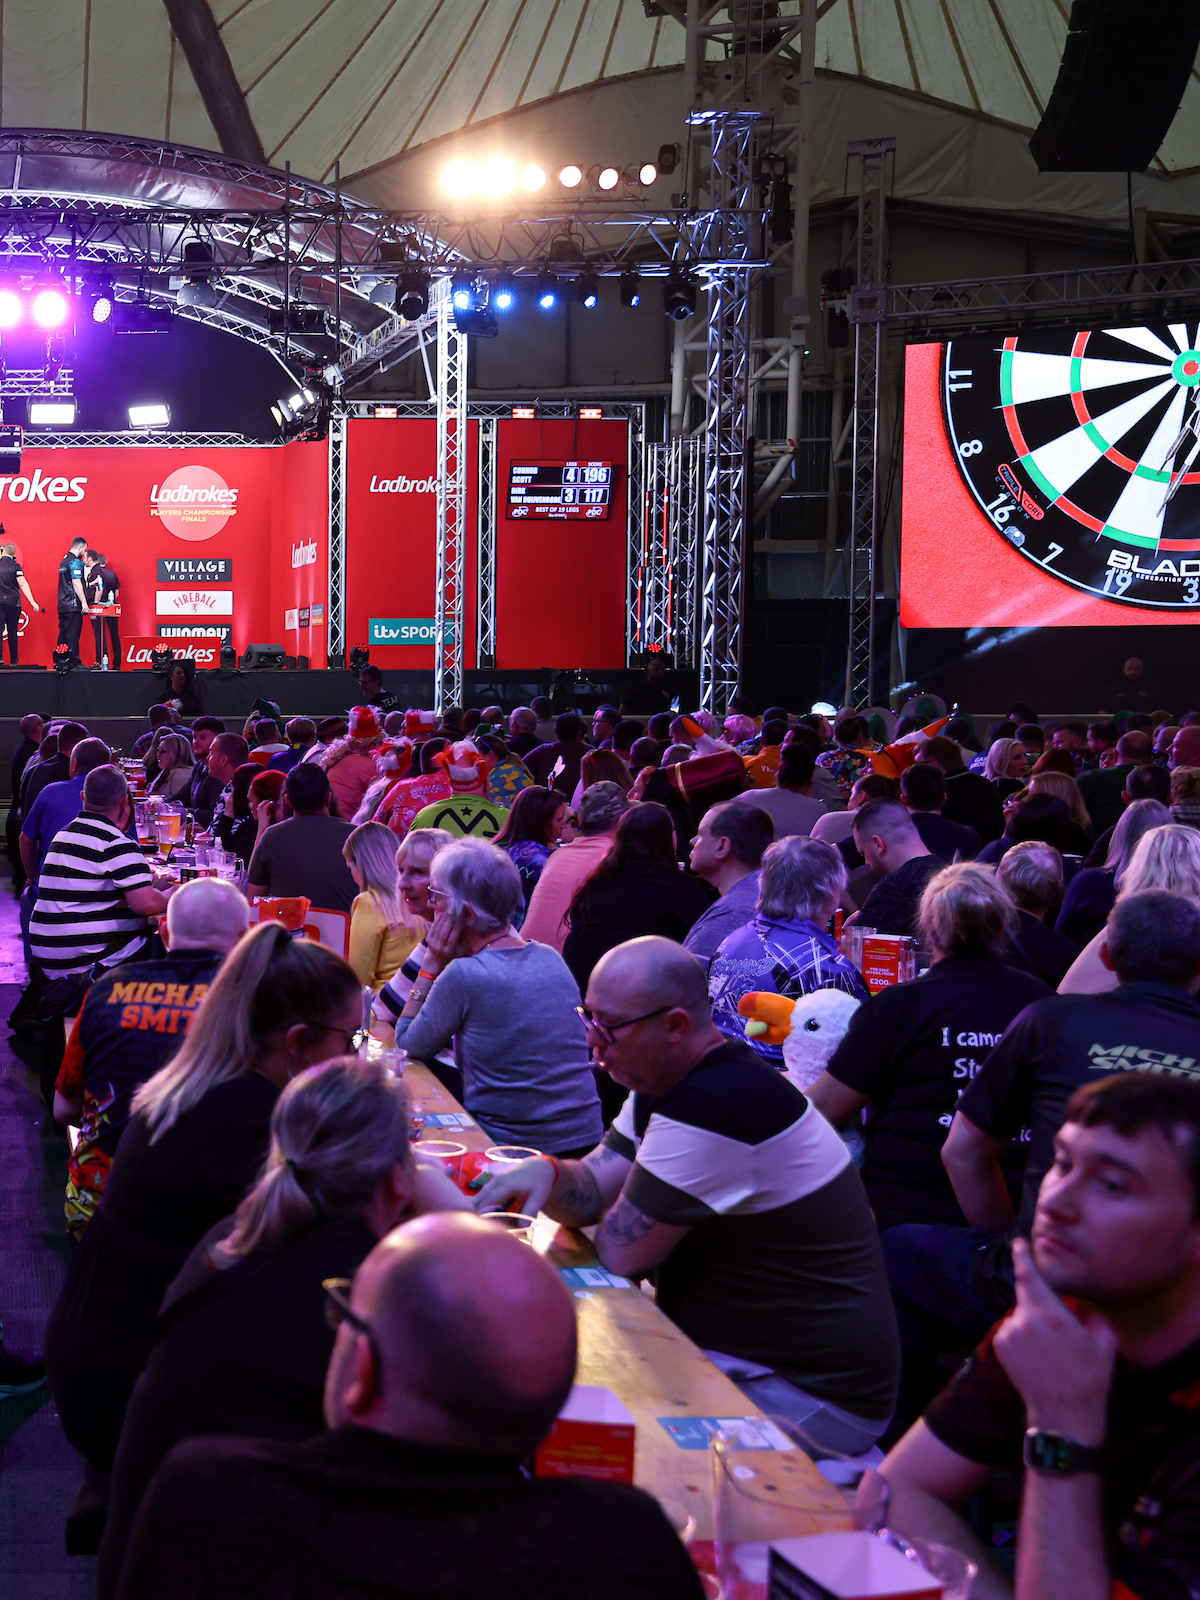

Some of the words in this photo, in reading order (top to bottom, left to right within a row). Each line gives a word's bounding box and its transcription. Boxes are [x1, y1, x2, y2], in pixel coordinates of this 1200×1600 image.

[949, 370, 973, 392] 11
[960, 439, 984, 458] 8
[512, 467, 539, 475] CONNOR
[566, 467, 576, 483] 4
[583, 467, 607, 483] 196
[512, 476, 532, 484] SCUTT
[150, 484, 239, 503] Ladbrokes
[510, 496, 523, 504] VAN
[511, 487, 526, 495] DIRK
[564, 488, 574, 503] 3
[584, 488, 604, 503] 117
[987, 493, 1016, 523] 16
[1023, 498, 1043, 519] CORE
[1042, 541, 1064, 564] 7
[164, 560, 226, 573] VILLAGE
[1104, 568, 1133, 597] 19
[1135, 572, 1182, 583] GENERATION
[173, 592, 217, 610] FIREBALL
[1182, 579, 1200, 604] 3
[374, 624, 400, 639] itv
[870, 978, 889, 986] £200
[107, 982, 209, 1008] MICHA
[120, 1005, 197, 1036] SMIT
[941, 1026, 950, 1047] I
